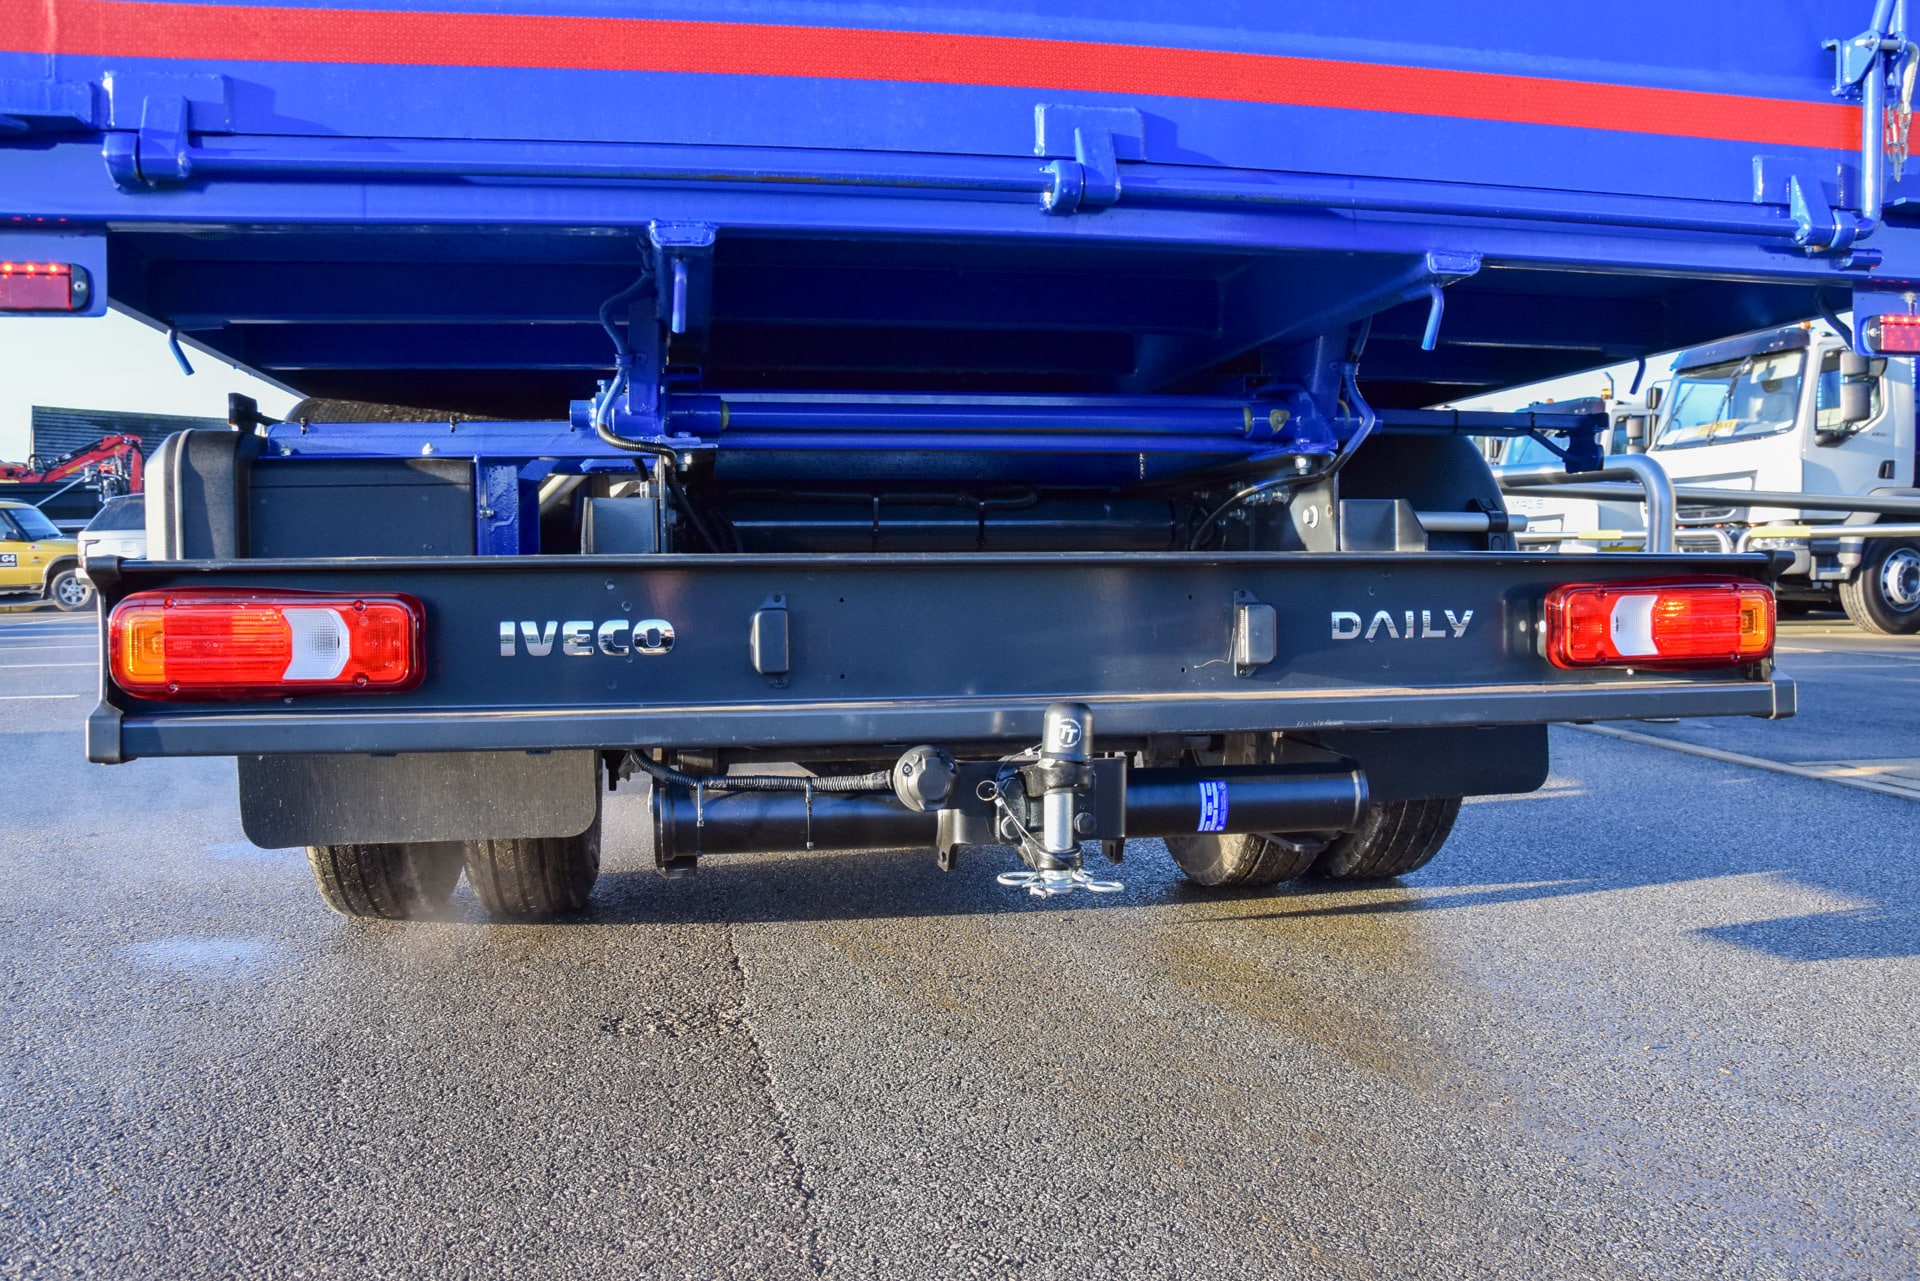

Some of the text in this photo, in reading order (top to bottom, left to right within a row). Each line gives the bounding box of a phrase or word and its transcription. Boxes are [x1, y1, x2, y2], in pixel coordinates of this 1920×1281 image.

[1, 554, 16, 562] G4
[500, 619, 675, 656] IVECO
[1331, 610, 1474, 639] DAILY
